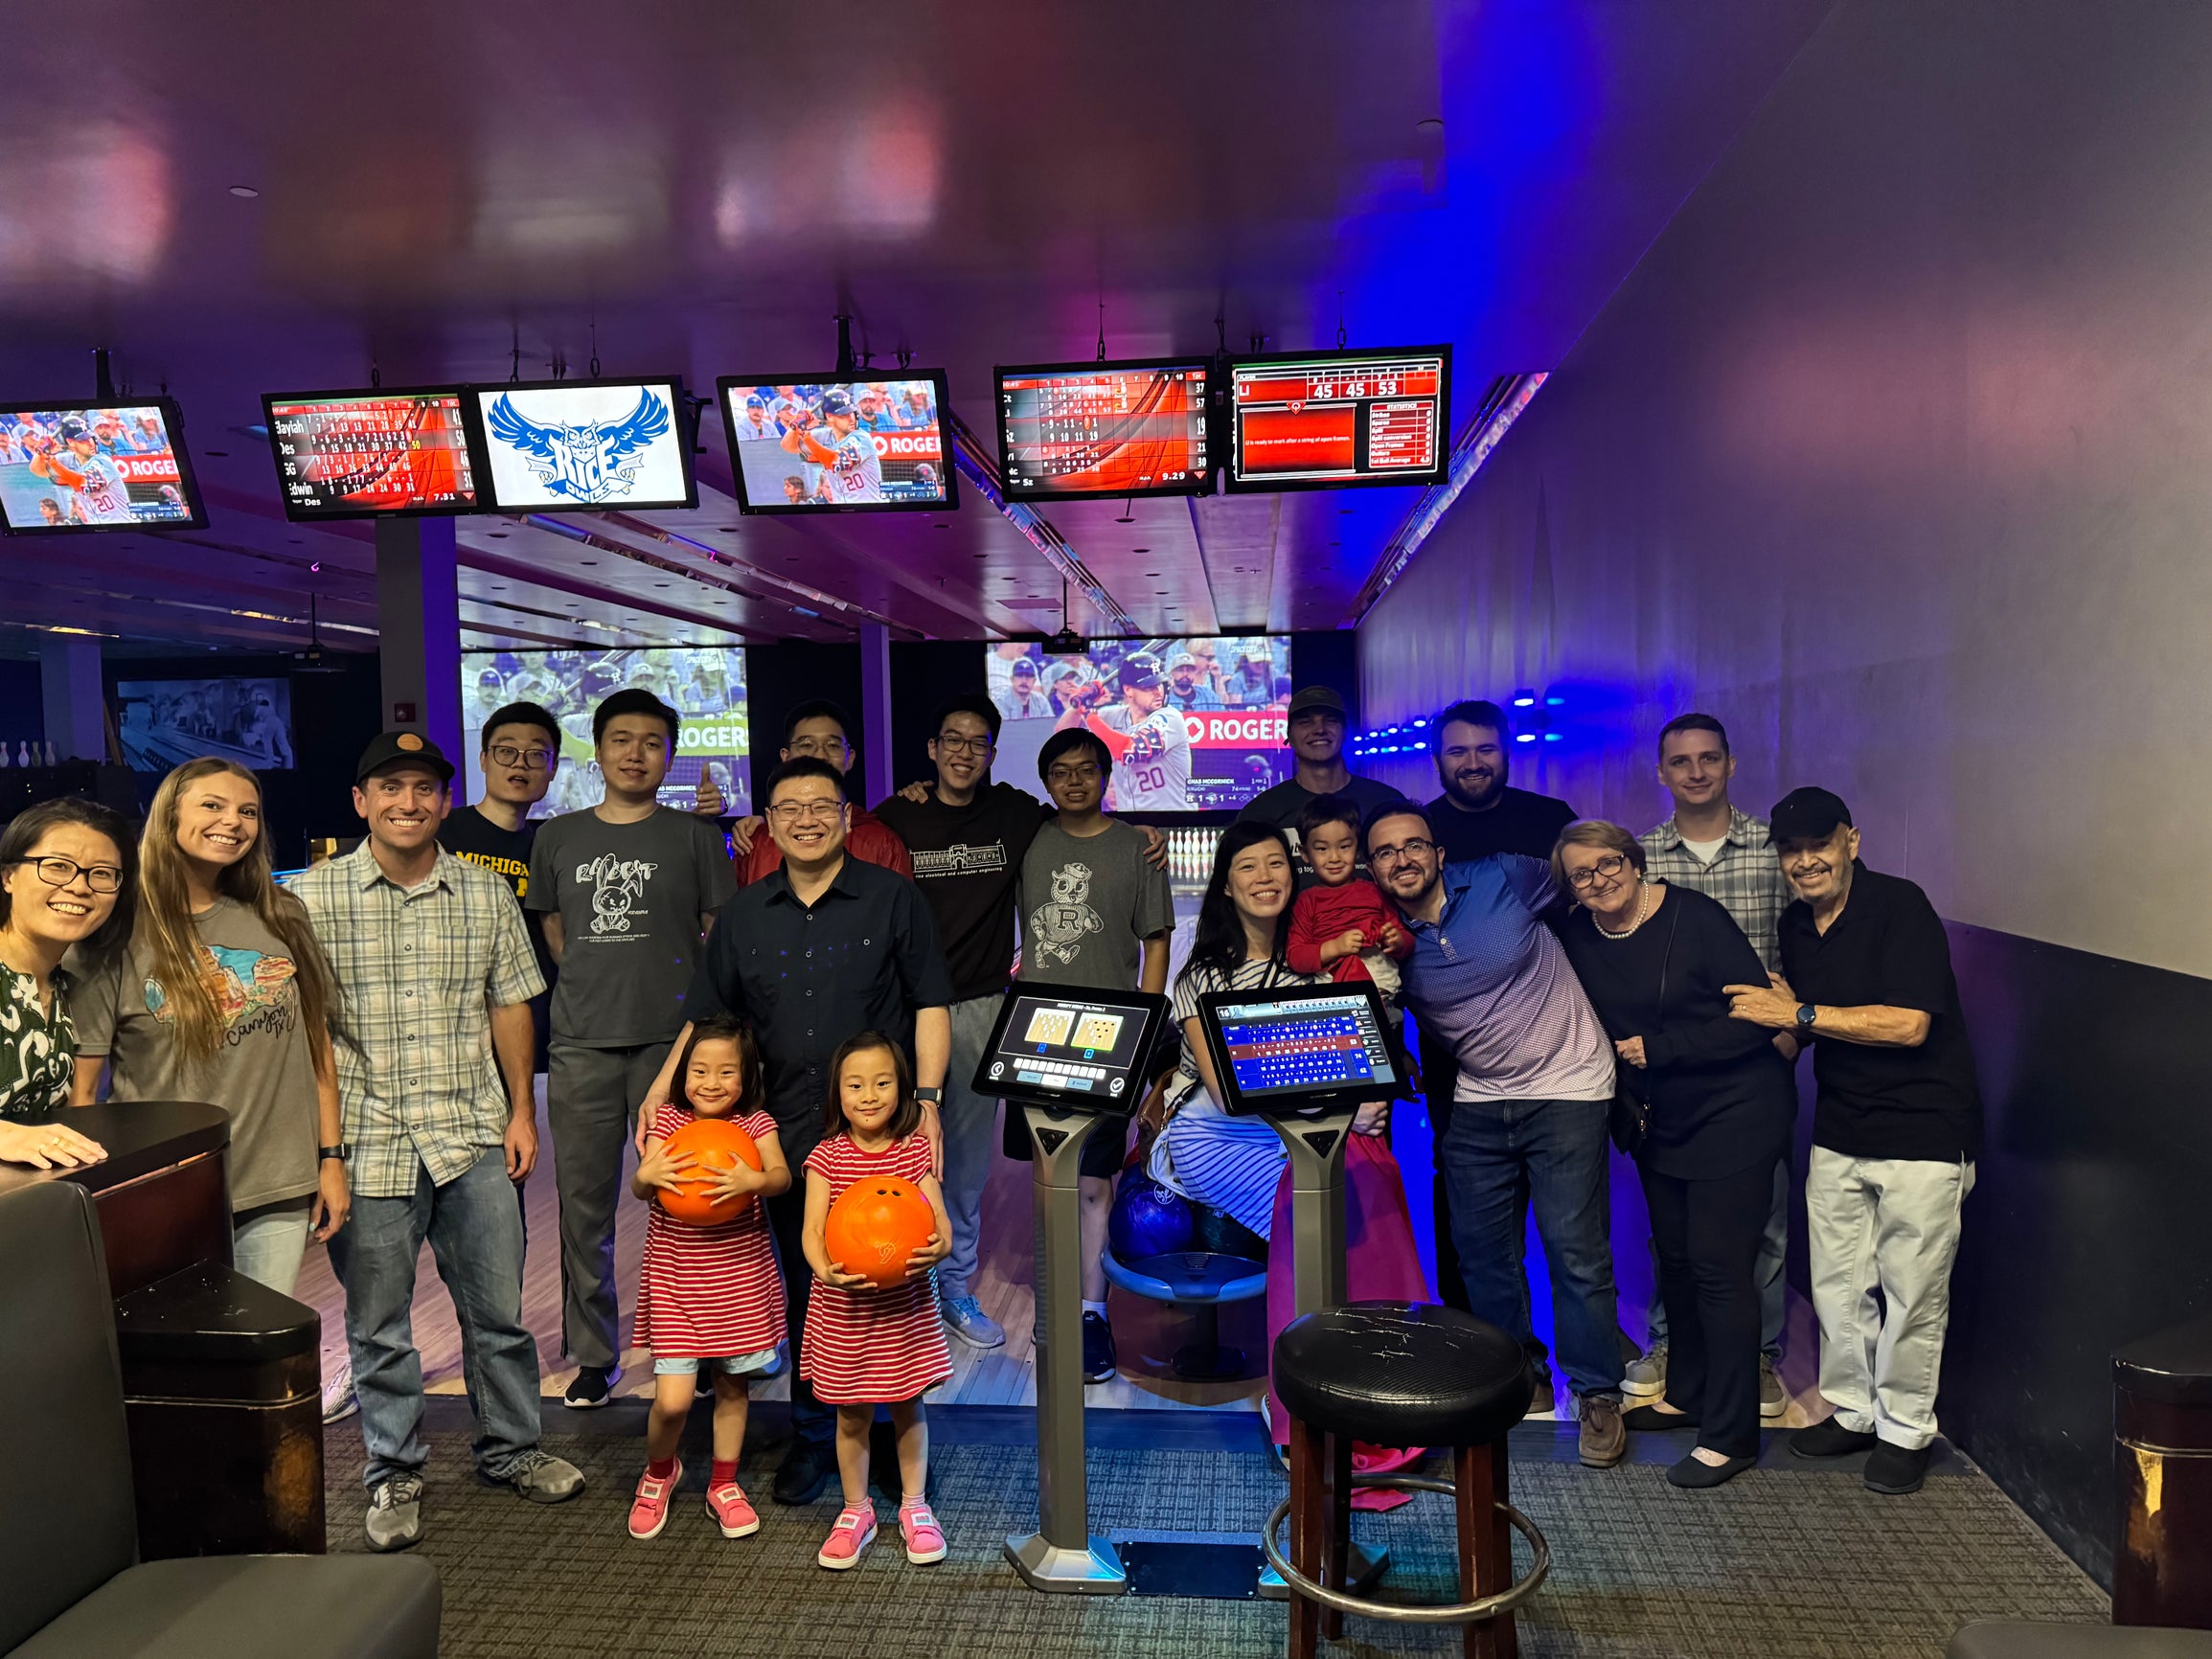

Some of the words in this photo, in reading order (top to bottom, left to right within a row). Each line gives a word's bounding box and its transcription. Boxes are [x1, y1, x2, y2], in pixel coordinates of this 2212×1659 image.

[1196, 383, 1204, 393] 37
[1314, 385, 1333, 398] 45
[1346, 383, 1365, 397] 45
[1378, 381, 1396, 395] 53
[1196, 398, 1204, 408] 57
[453, 408, 462, 425] 41
[340, 423, 348, 432] 13
[354, 422, 362, 431] 13
[367, 422, 376, 430] 21
[408, 420, 416, 429] 41
[1197, 417, 1206, 435] 19
[456, 430, 465, 446] 50
[1061, 433, 1069, 442] 10
[1075, 432, 1083, 441] 11
[1090, 431, 1098, 441] 19
[331, 444, 339, 453] 15
[345, 443, 353, 452] 18
[358, 443, 366, 452] 21
[371, 442, 380, 451] 30
[385, 442, 392, 450] 37
[399, 442, 407, 450] 42
[412, 441, 420, 449] 50
[1197, 442, 1206, 452] 21
[460, 450, 469, 467] 46
[549, 434, 615, 491] RICE
[1198, 457, 1206, 467] 30
[322, 466, 330, 474] 13
[335, 465, 343, 474] 16
[1162, 472, 1185, 480] 9.29
[464, 471, 473, 488] 31
[844, 474, 865, 492] 20
[353, 485, 360, 493] 17
[393, 483, 401, 492] 30
[406, 483, 415, 491] 31
[565, 481, 610, 500] OWLS
[94, 495, 114, 513] 20
[1136, 767, 1165, 792] 20
[1057, 908, 1082, 932] R
